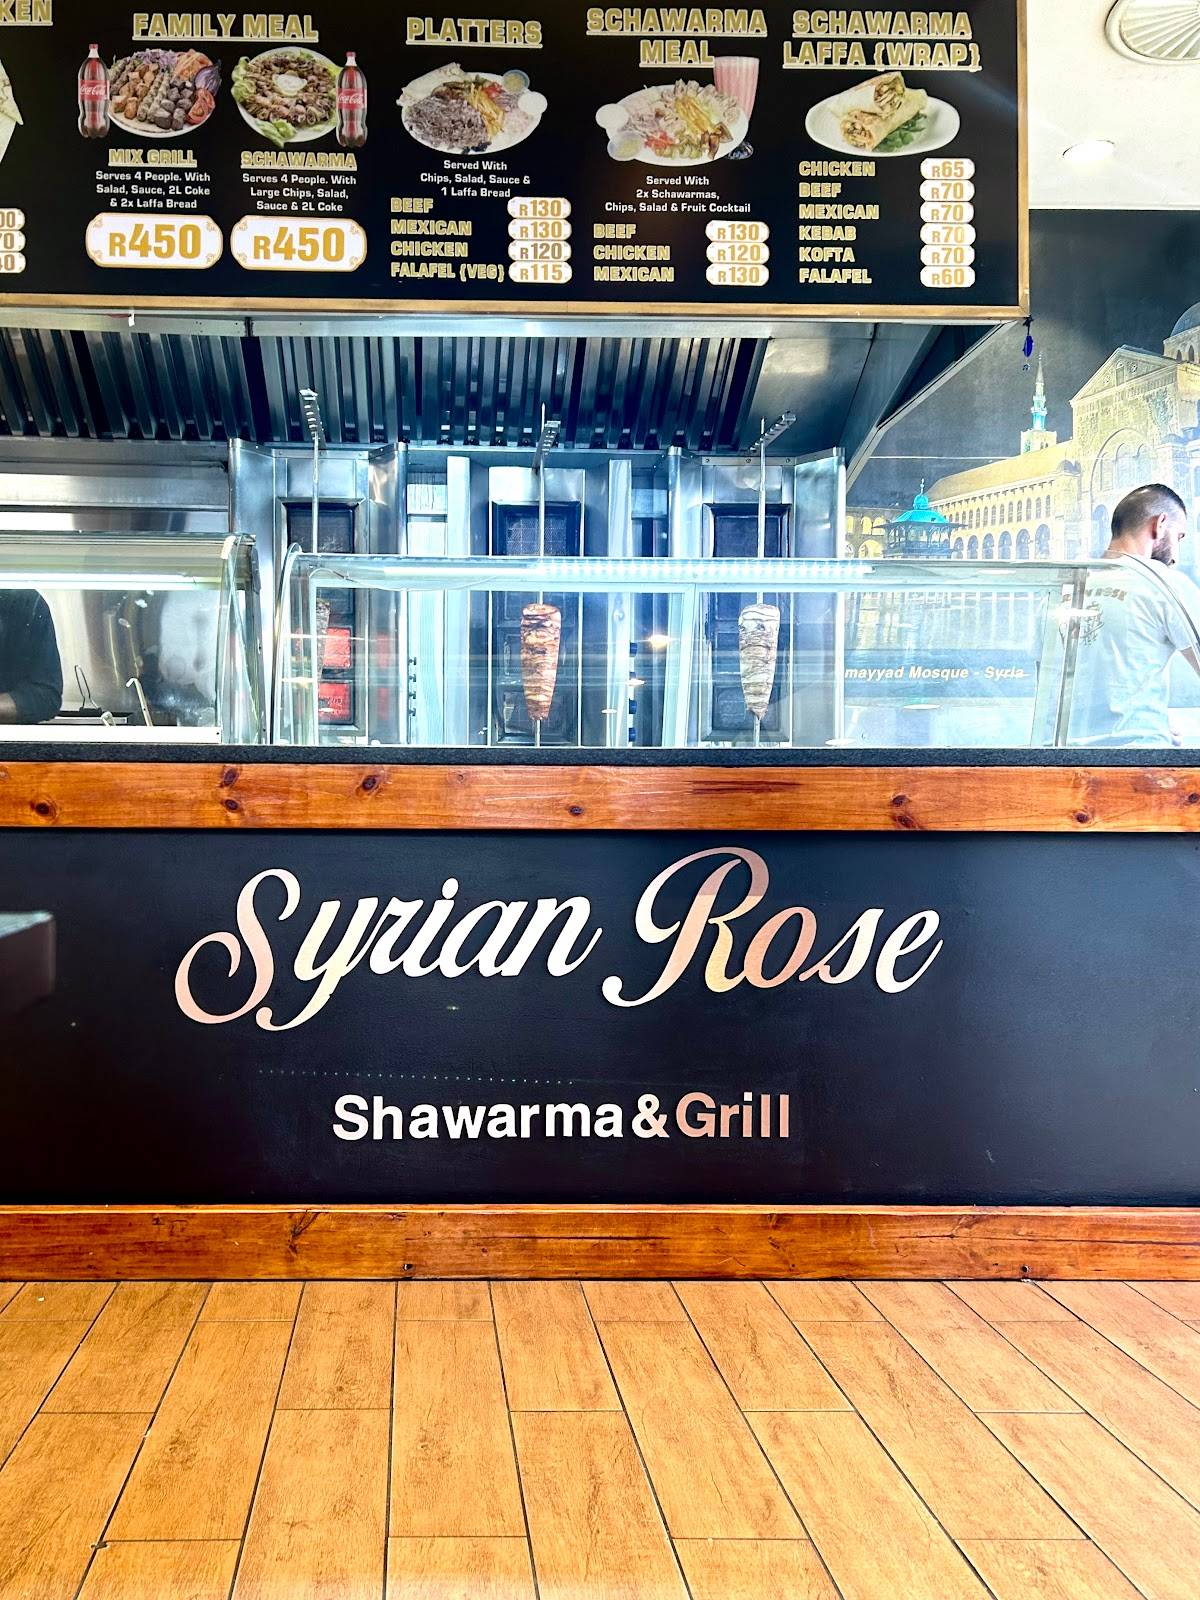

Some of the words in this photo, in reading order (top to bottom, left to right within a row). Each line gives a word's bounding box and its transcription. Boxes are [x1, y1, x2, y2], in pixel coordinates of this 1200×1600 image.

[133, 13, 236, 38] FAMILY
[243, 14, 318, 39] MEAL
[587, 8, 767, 34] SCHAWARMA
[793, 10, 972, 36] SCHAWARMA
[407, 18, 542, 44] PLATTERS
[641, 40, 714, 64] MEAL
[783, 42, 867, 66] LAFFA
[109, 149, 142, 164] MIX
[147, 150, 196, 165] GRILL
[242, 152, 357, 168] SCHAWARMA
[443, 160, 478, 170] Served
[479, 161, 507, 171] With
[799, 162, 875, 177] CHICKEN
[931, 162, 964, 178] R65
[96, 171, 131, 181] Serves
[134, 172, 142, 181] 4
[145, 172, 181, 184] People.
[185, 172, 210, 182] With
[243, 174, 278, 184] Serves
[281, 175, 288, 183] 4
[291, 175, 328, 187] People.
[331, 175, 356, 185] With
[420, 173, 452, 184] Chips,
[455, 174, 487, 186] Salad,
[489, 175, 520, 185] Sauce
[523, 176, 530, 185] &
[646, 176, 680, 186] Served
[682, 176, 709, 186] With
[96, 184, 128, 196] Salad,
[131, 185, 165, 197] Sauce,
[168, 186, 182, 195] 2L
[185, 186, 210, 196] Coke
[251, 187, 279, 200] Large
[282, 188, 314, 200] Chips,
[317, 188, 348, 200] Salad,
[441, 187, 447, 196] 1
[450, 187, 478, 197] Laffa
[481, 188, 510, 198] Bread
[636, 189, 649, 199] 2x
[652, 189, 719, 200] Schawarmas,
[799, 183, 841, 198] BEEF
[931, 183, 964, 200] R70
[110, 198, 118, 207] &
[121, 198, 133, 208] 2x
[137, 198, 163, 208] Laffa
[166, 199, 197, 209] Bread
[257, 201, 288, 211] Sauce
[291, 202, 299, 211] &
[302, 202, 314, 211] 2L
[318, 202, 343, 212] Coke
[391, 198, 433, 213] BEEF
[519, 199, 562, 218] R130
[605, 202, 637, 213] Chips,
[639, 202, 668, 212] Salad
[671, 203, 678, 212] &
[681, 203, 706, 212] Fruit
[709, 203, 750, 213] Cocktail
[799, 205, 879, 219] MEXICAN
[931, 205, 964, 221] R70
[391, 220, 472, 236] MEXICAN
[519, 221, 562, 238] R130
[594, 224, 636, 239] BEEF
[718, 223, 760, 241] R130
[799, 226, 856, 241] KEBAB
[931, 227, 964, 243] R70
[108, 224, 200, 259] R450
[253, 228, 345, 261] R450
[391, 241, 468, 257] CHICKEN
[519, 242, 562, 260] R120
[594, 245, 670, 260] CHICKEN
[718, 244, 760, 262] R120
[799, 248, 855, 262] KOFTA
[931, 248, 964, 264] R70
[391, 262, 455, 278] FALAFEL
[520, 264, 562, 281] R115
[594, 267, 674, 282] MEXICAN
[718, 266, 760, 283] R130
[799, 269, 871, 284] FALAFEL
[931, 269, 964, 285] R60
[909, 666, 968, 680] Mosque
[984, 666, 1024, 681] Syria
[174, 868, 602, 1031] Syrian
[601, 846, 944, 1008] Rose
[332, 1095, 623, 1142] Shawarma
[675, 1091, 791, 1139] Grill
